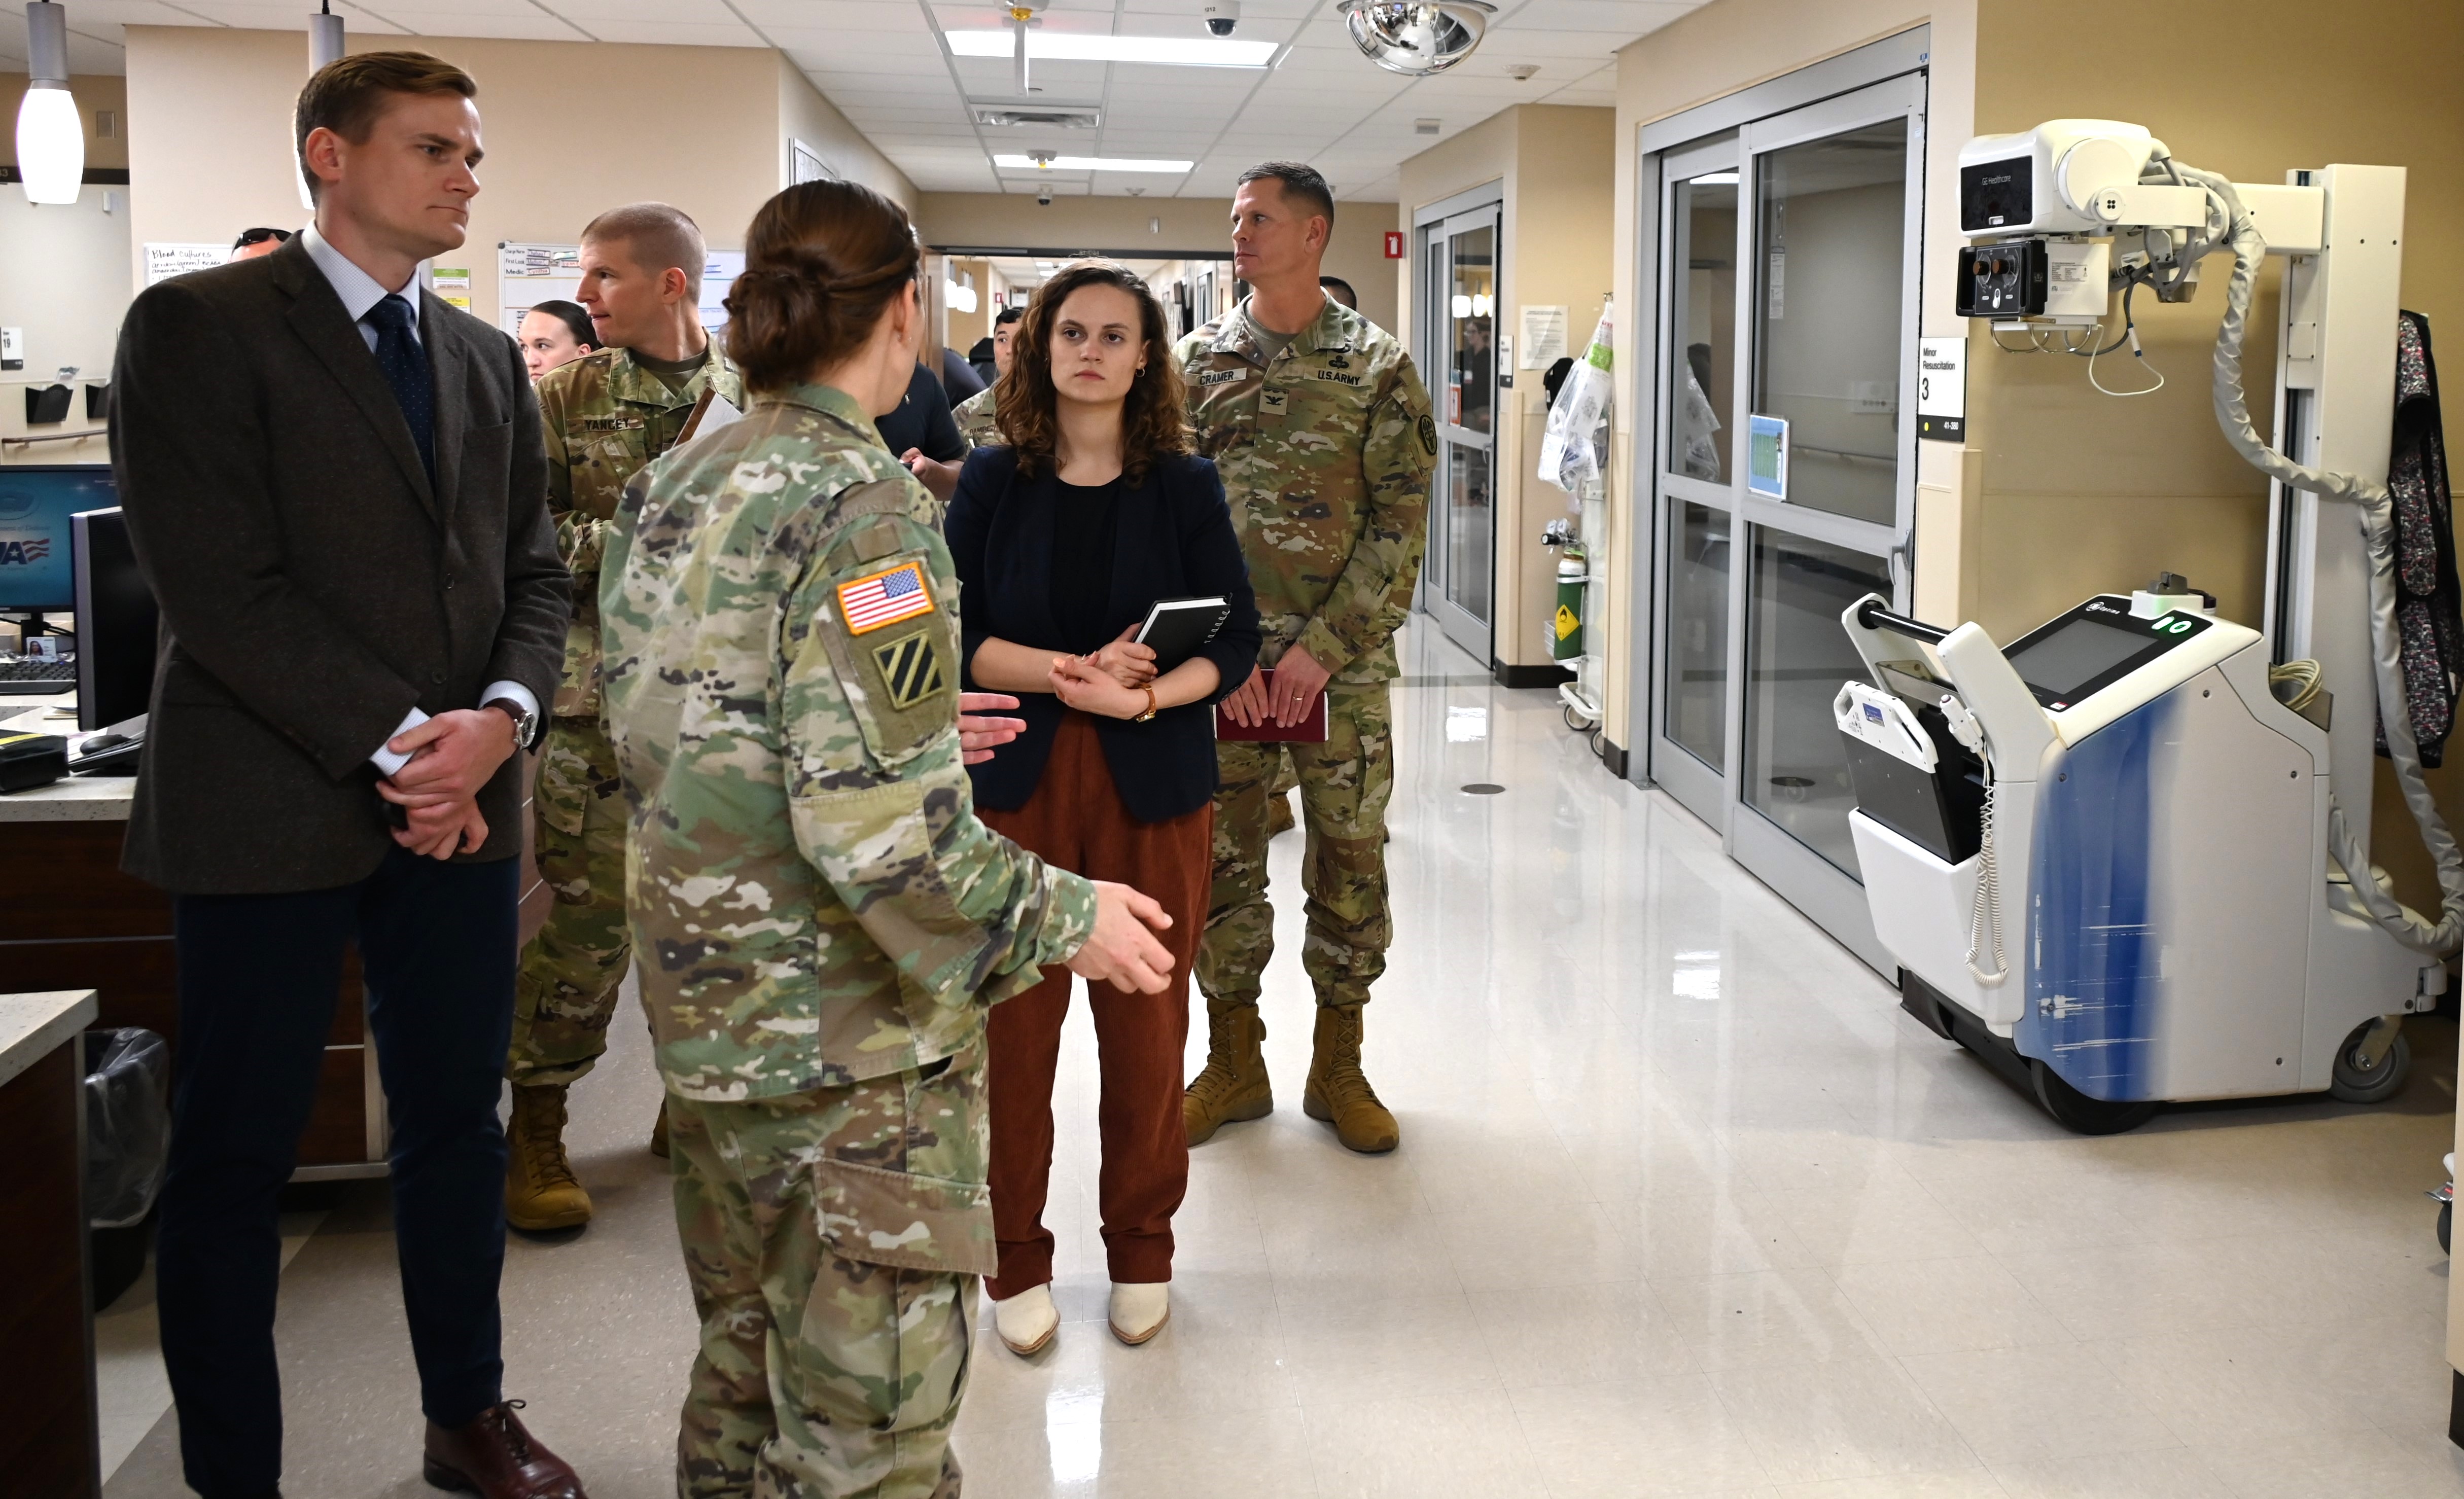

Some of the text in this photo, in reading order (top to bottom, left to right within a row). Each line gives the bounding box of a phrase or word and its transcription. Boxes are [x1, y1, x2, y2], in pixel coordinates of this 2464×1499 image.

[1982, 174, 2011, 185] GE Healthcare
[152, 249, 175, 259] Blood
[3, 338, 11, 348] 19
[1923, 348, 1937, 356] Minor
[1923, 361, 1955, 370] Resuscitation
[1200, 371, 1234, 385] CRAMER
[1922, 377, 1929, 400] 3
[586, 417, 629, 431] YANCEY
[1944, 421, 1959, 430] 41-380
[969, 425, 994, 435] RAMIREZ
